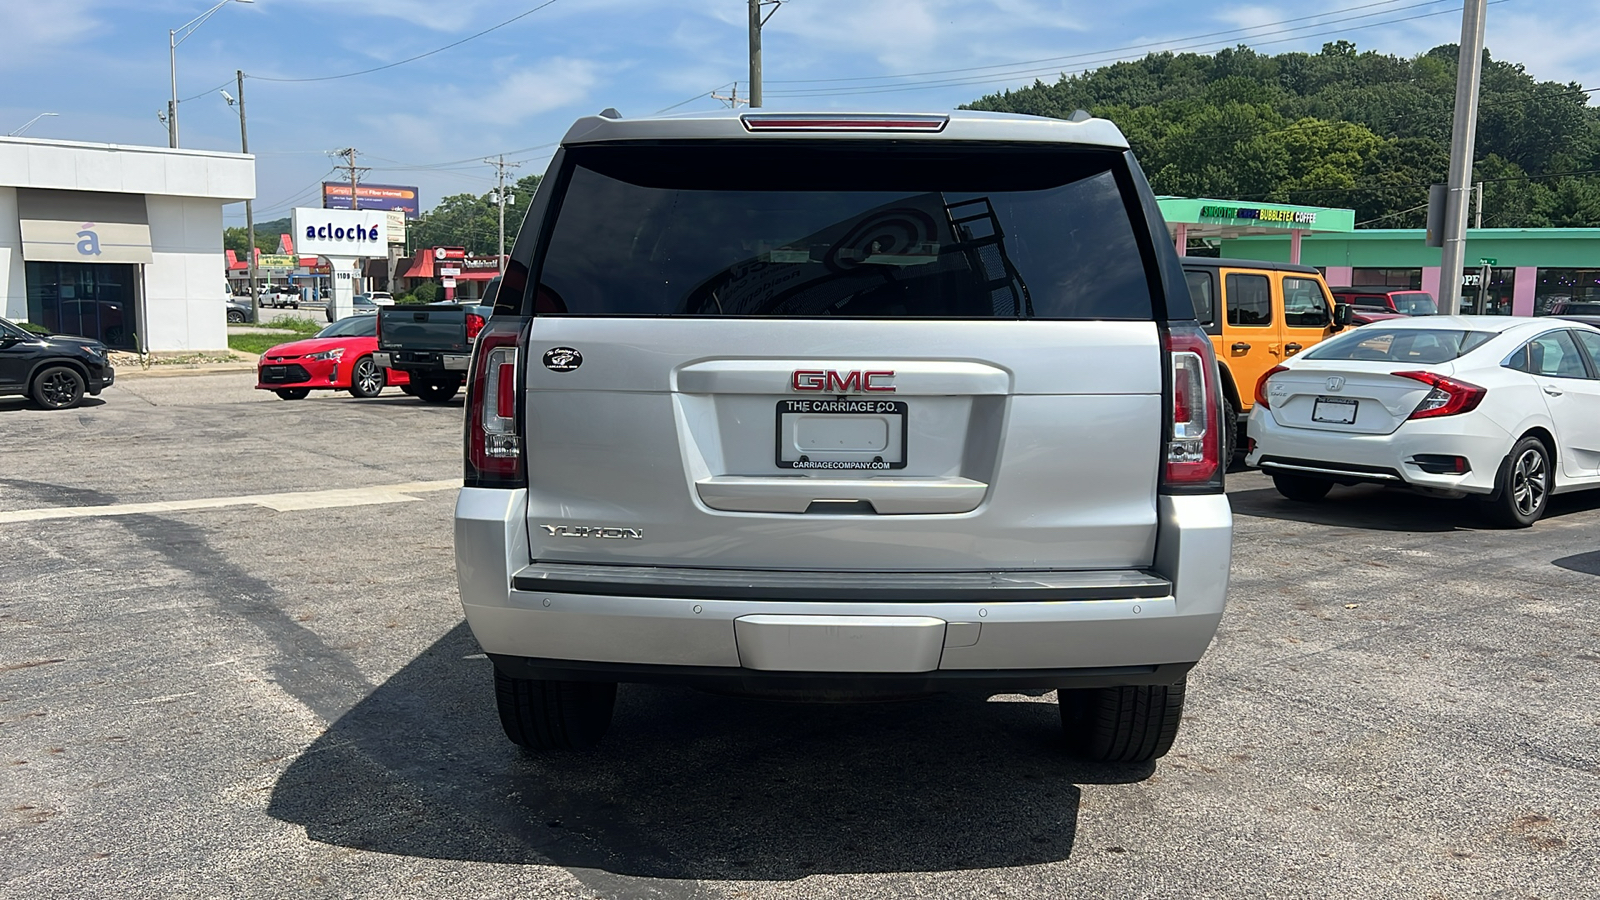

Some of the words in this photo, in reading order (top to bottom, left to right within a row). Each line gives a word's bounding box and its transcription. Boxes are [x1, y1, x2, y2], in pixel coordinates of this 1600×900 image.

[1260, 209, 1294, 222] BUBBLETEA
[1295, 211, 1317, 224] COFFEE
[76, 222, 102, 256] á
[306, 222, 379, 241] acloché
[792, 369, 896, 392] GMC
[786, 401, 810, 411] THE
[812, 401, 875, 412] CARRIAGE
[876, 401, 898, 412] CO.
[792, 461, 890, 469] CARRIAGECOMPANY.COM
[540, 524, 644, 539] YUKON
